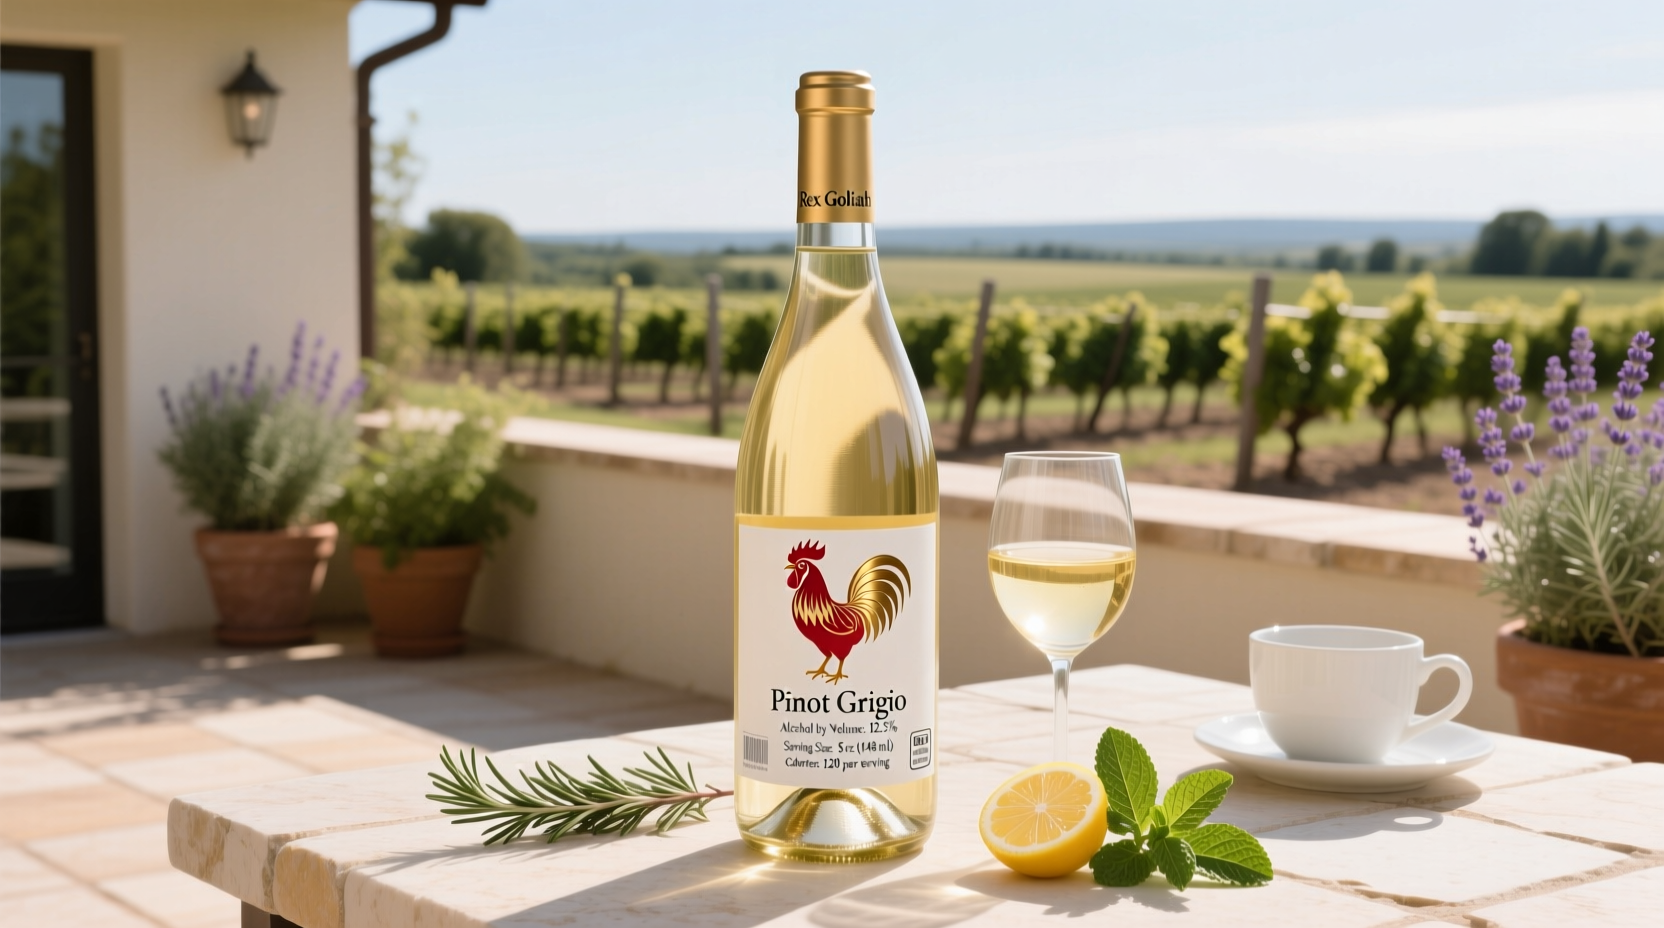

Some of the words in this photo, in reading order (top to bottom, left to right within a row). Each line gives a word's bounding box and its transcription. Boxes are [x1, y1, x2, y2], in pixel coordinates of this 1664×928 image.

[800, 190, 822, 207] Rex
[770, 688, 831, 714] Pinot
[836, 689, 907, 720] Grigio
[816, 722, 827, 737] by
[823, 757, 841, 769] 120
